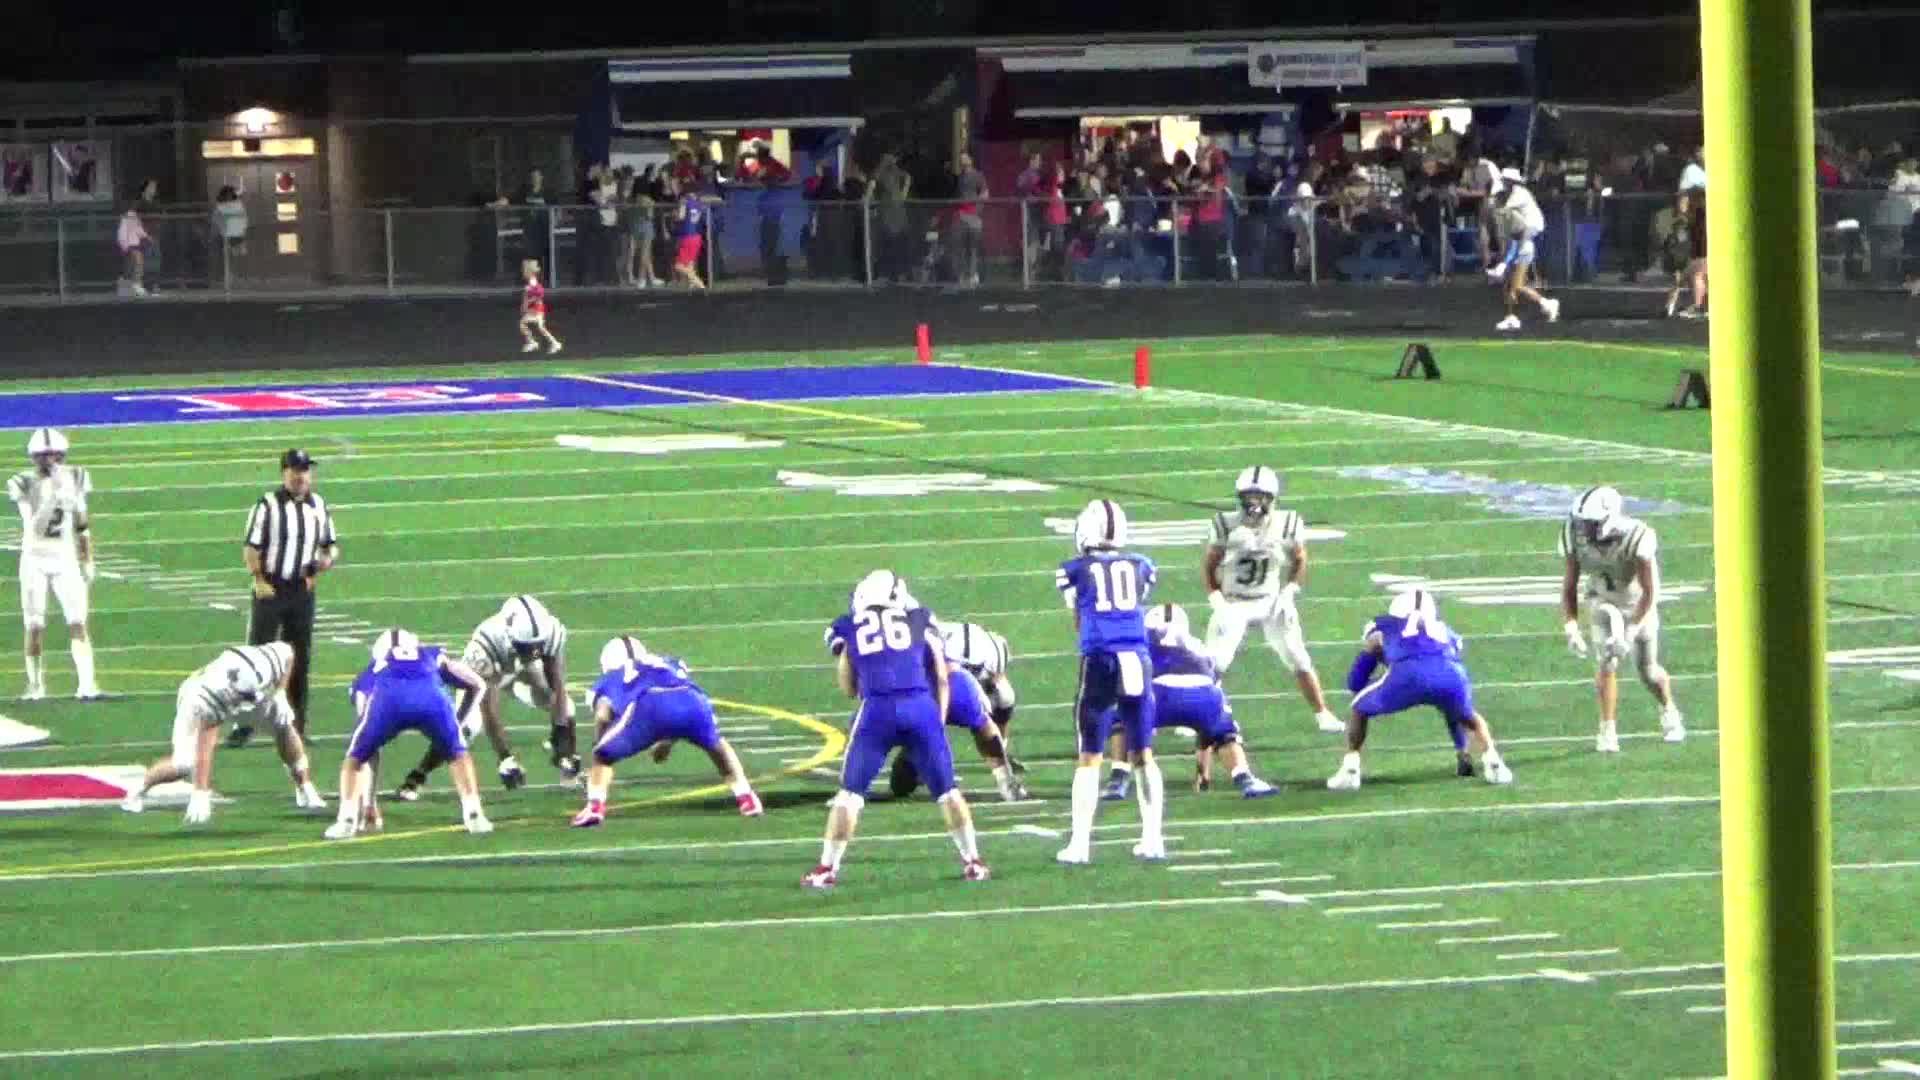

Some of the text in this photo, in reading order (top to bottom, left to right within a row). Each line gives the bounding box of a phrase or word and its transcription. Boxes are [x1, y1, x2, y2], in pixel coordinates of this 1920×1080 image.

[44, 507, 64, 538] 2
[1089, 560, 1137, 612] 10
[1236, 557, 1270, 585] 31
[854, 608, 912, 656] 26
